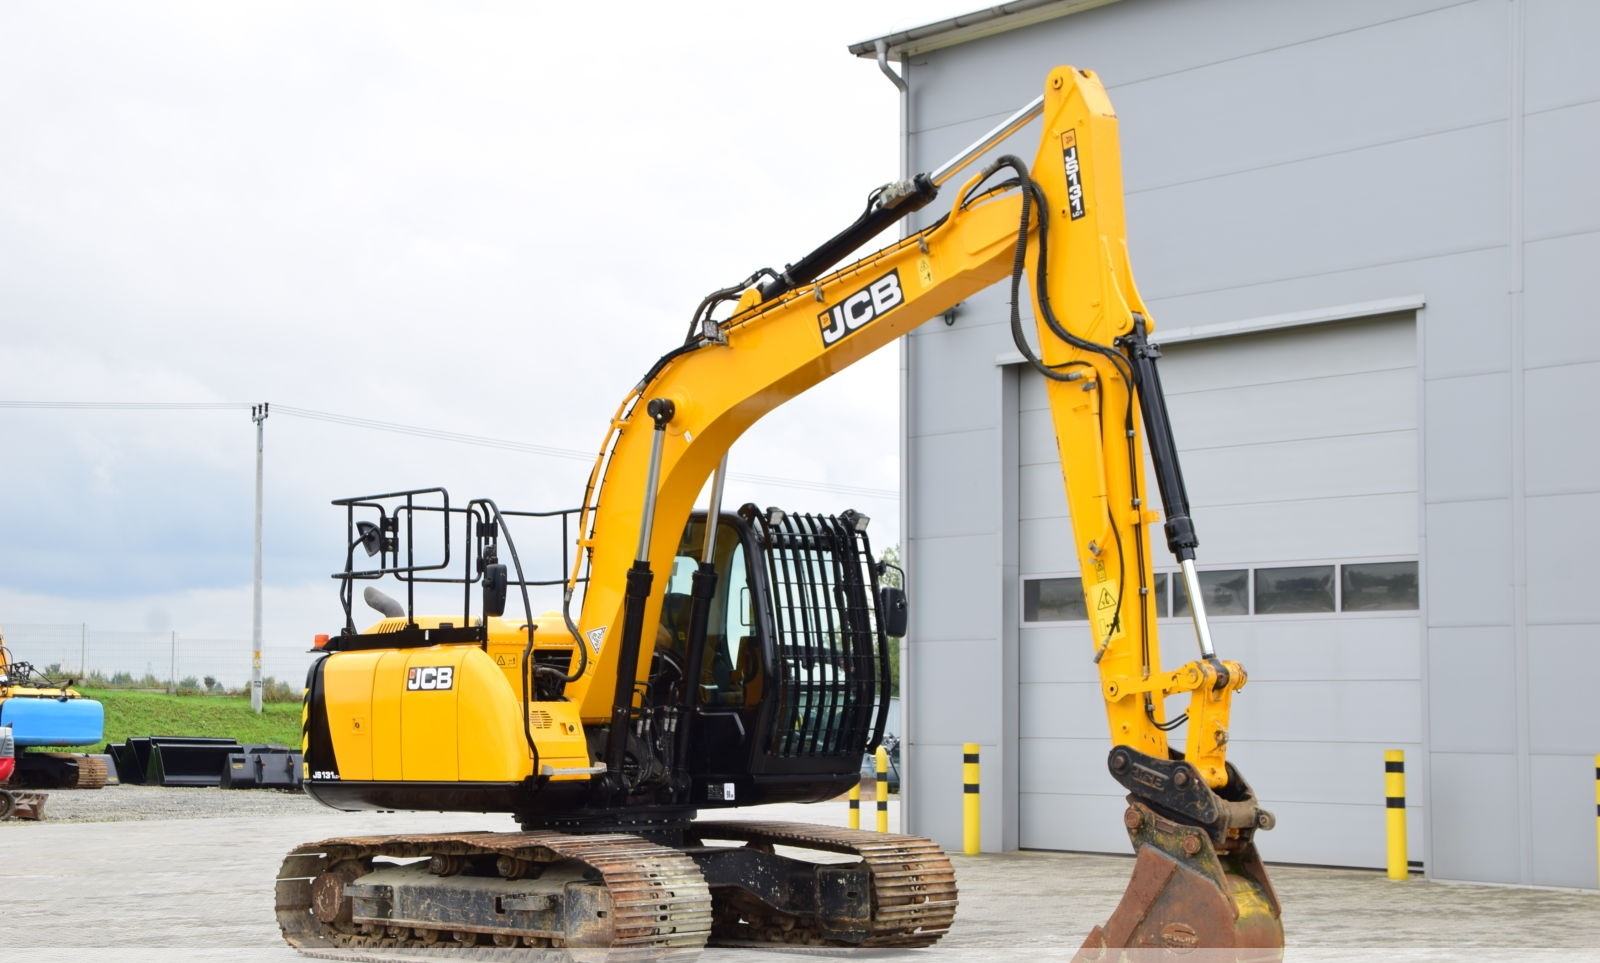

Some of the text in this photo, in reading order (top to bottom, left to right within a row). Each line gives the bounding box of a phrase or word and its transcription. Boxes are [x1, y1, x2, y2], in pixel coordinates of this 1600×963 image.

[1065, 147, 1082, 211] JS131
[823, 273, 902, 344] JCB
[408, 667, 453, 690] JCB
